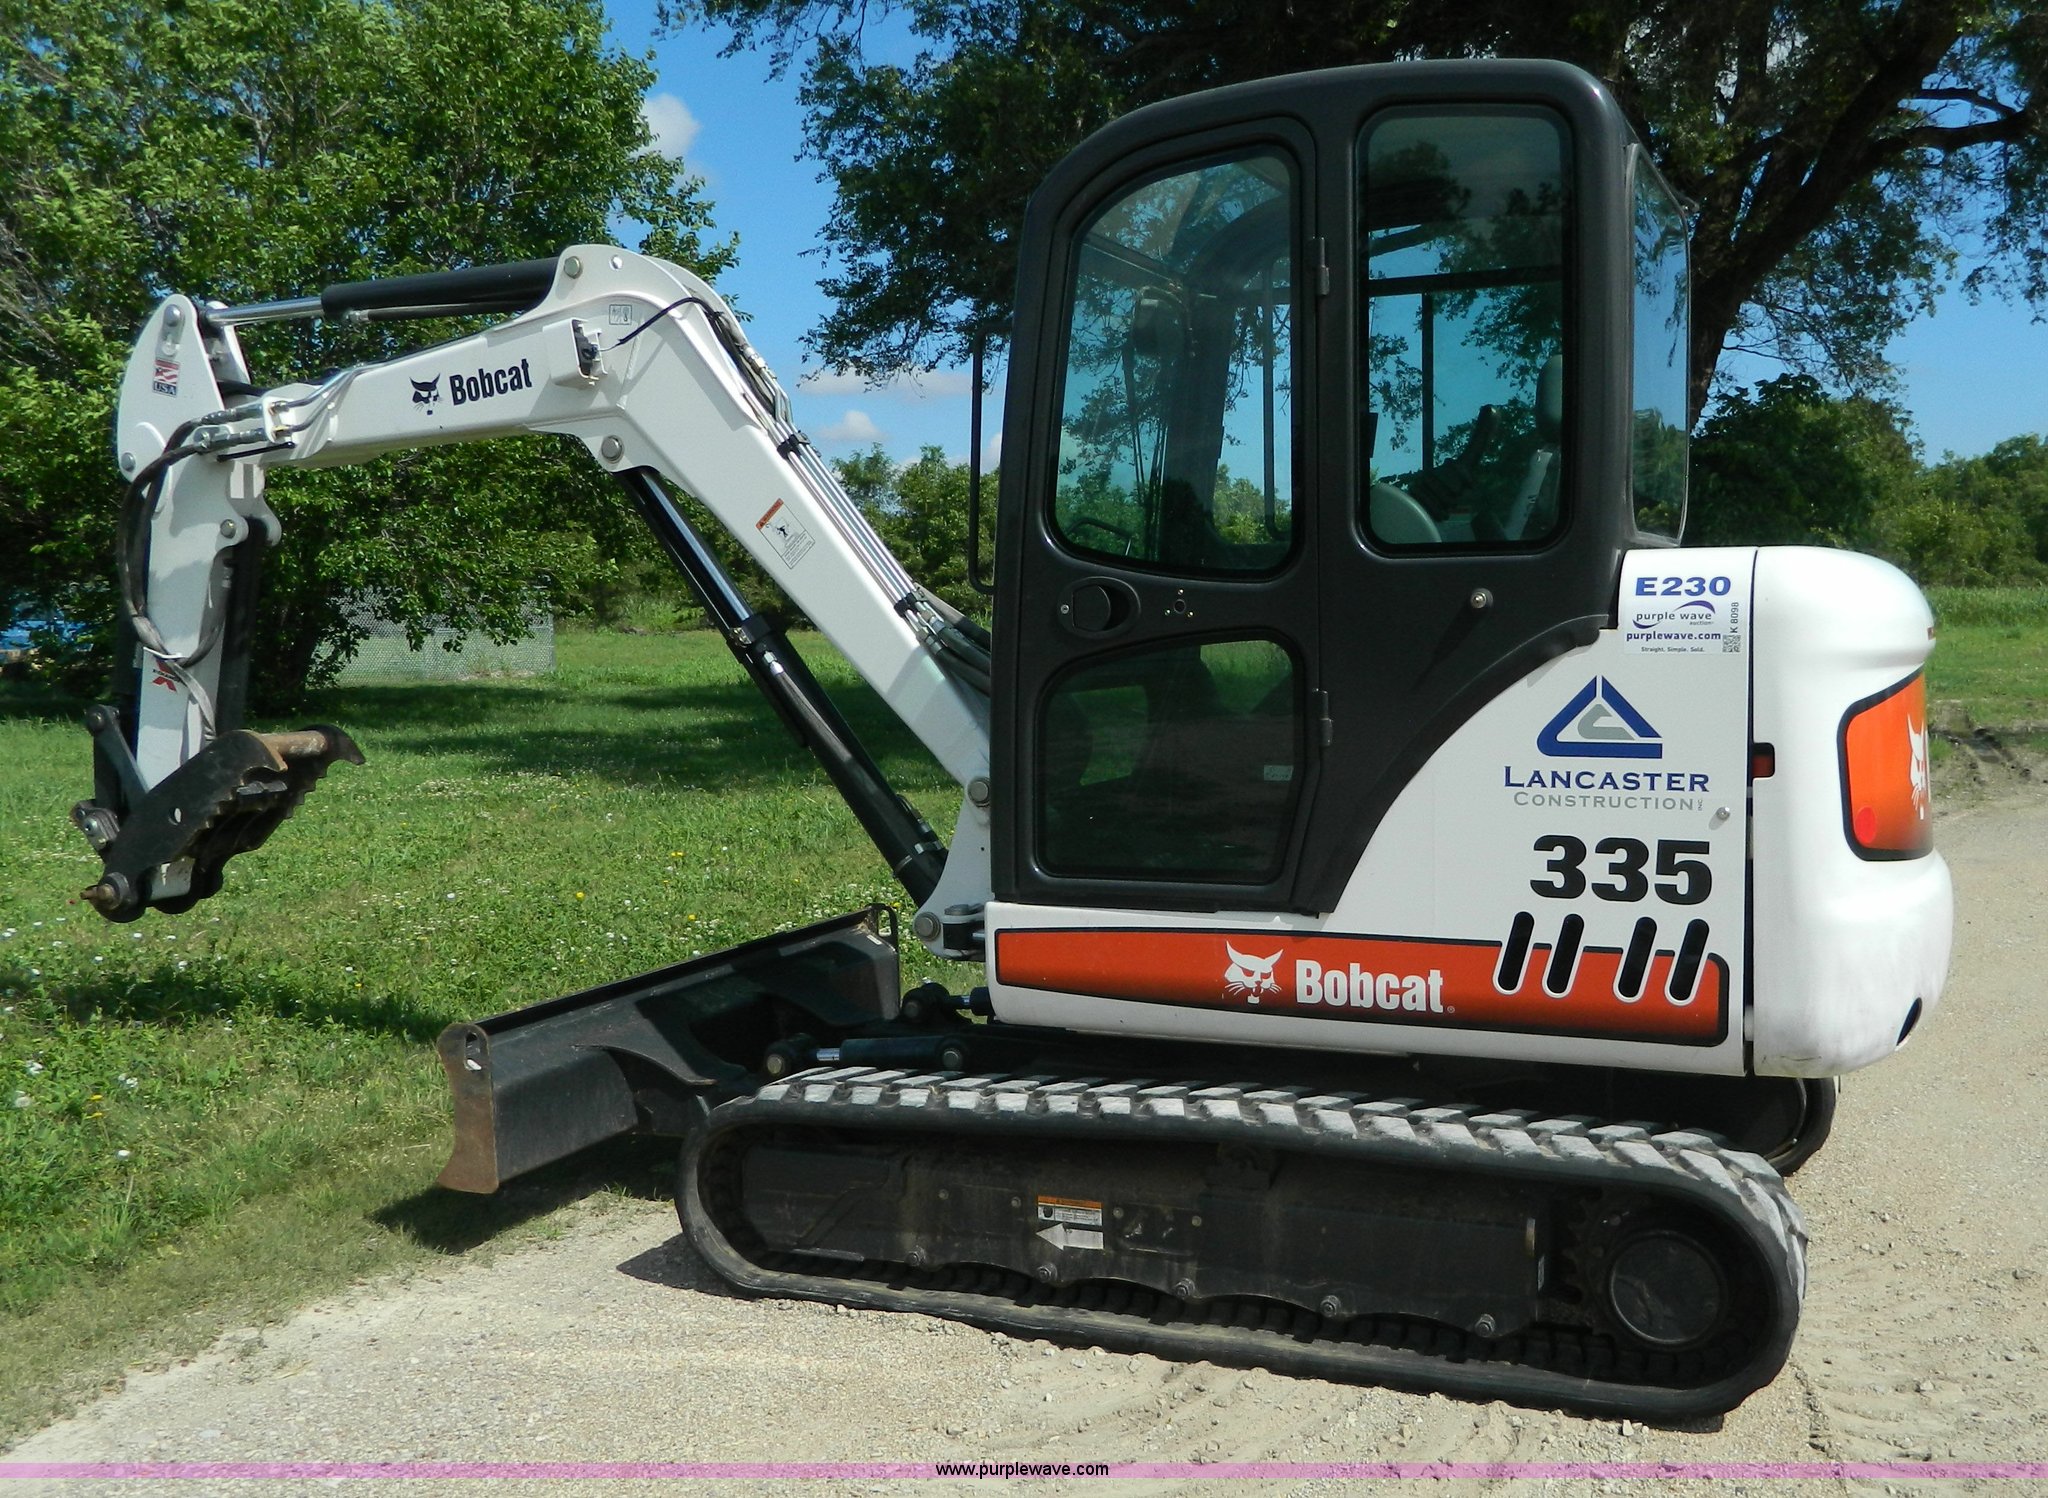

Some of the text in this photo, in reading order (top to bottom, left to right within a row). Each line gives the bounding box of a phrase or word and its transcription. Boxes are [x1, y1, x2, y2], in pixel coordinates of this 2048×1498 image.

[154, 381, 177, 395] USA
[449, 358, 532, 406] Bobcat
[1635, 576, 1731, 596] E230
[1636, 612, 1712, 621] purple wave
[1730, 602, 1739, 634] K 8098
[1626, 631, 1721, 641] purplewave.com
[1530, 834, 1713, 905] 335
[1295, 959, 1444, 1013] Bobcat
